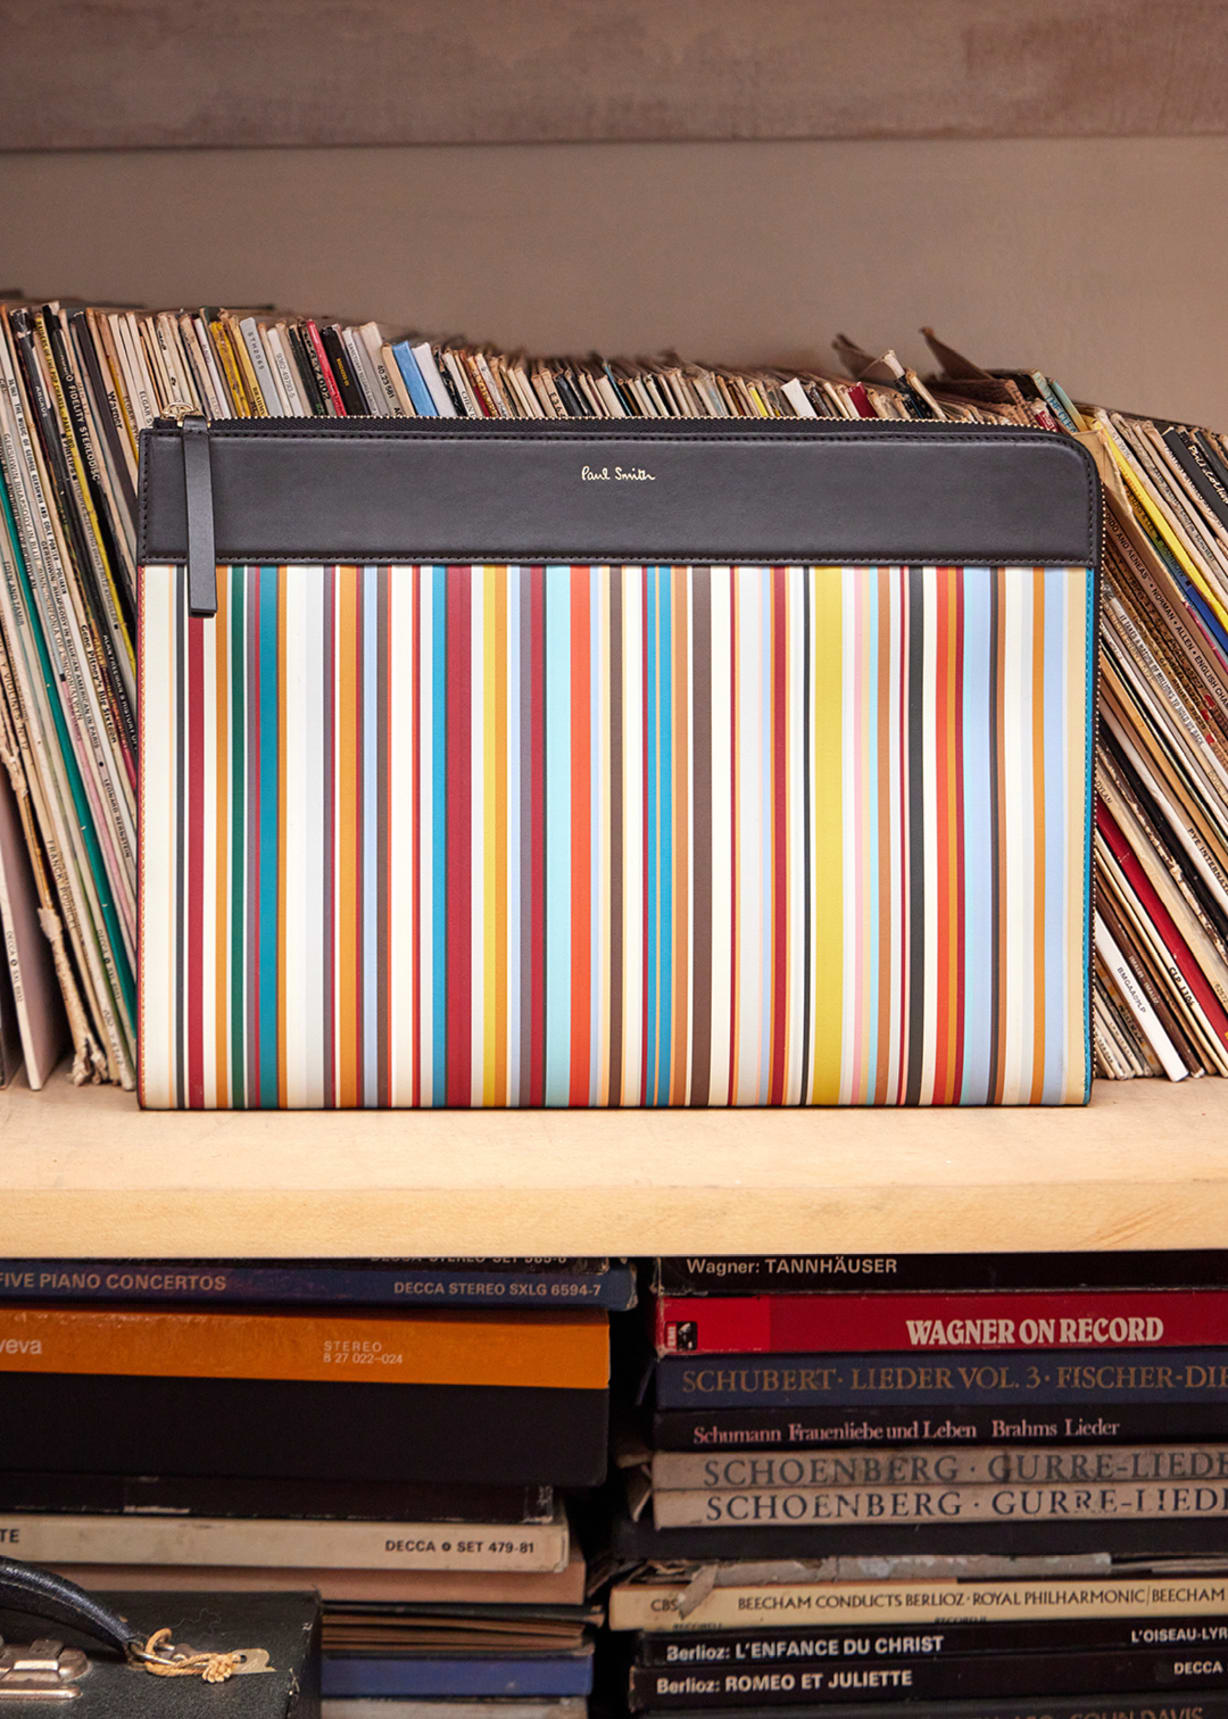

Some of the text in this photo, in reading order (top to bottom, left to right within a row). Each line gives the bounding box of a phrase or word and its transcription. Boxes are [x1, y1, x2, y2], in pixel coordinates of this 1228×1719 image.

[67, 384, 84, 423] FIDELITY
[106, 390, 123, 430] Wagner
[138, 390, 151, 416] ELGAR
[581, 465, 656, 481] Paul Smith
[1115, 531, 1131, 550] AND
[1150, 587, 1175, 620] NORMAN
[1174, 624, 1194, 651] ALLEN
[1193, 654, 1218, 688] ENGLISH
[80, 624, 92, 648] Gene
[1187, 827, 1201, 845] PYE
[1168, 966, 1182, 983] CLP
[687, 1256, 898, 1277] Wagner: TANNHÄUSER
[40, 1273, 100, 1289] PIANO
[106, 1274, 227, 1291] CONCERTOS
[394, 1282, 601, 1297] DECCA STEREO SXLG 6594-7
[906, 1317, 1164, 1345] WAGNER ON RECORD
[323, 1341, 382, 1353] STEREO
[335, 1353, 349, 1363] 27
[682, 1369, 836, 1393] SCHUBERT
[852, 1367, 953, 1390] LIEDER
[958, 1366, 1019, 1389] VOL.
[1026, 1366, 1041, 1389] 3
[693, 1418, 1120, 1444] Schumann Frauenliebe und Leben Brahms Lieder
[704, 1455, 959, 1487] SCHOENBERG
[706, 1491, 961, 1521] SCHOENBERG
[385, 1540, 534, 1554] DECCA SET 479-81
[651, 1599, 679, 1612] CBS
[738, 1596, 812, 1611] BEECHAM
[815, 1594, 903, 1609] CONDUCTS
[906, 1592, 965, 1608] BERLIOZ
[973, 1592, 1021, 1606] ROYAL
[1152, 1588, 1225, 1604] BEECHAM
[666, 1636, 944, 1662] Berlioz: L'ENFANCE DU CHRIST
[1174, 1660, 1223, 1675] DECCA
[657, 1670, 913, 1695] Berlioz: ROMEO ET JULIETTE
